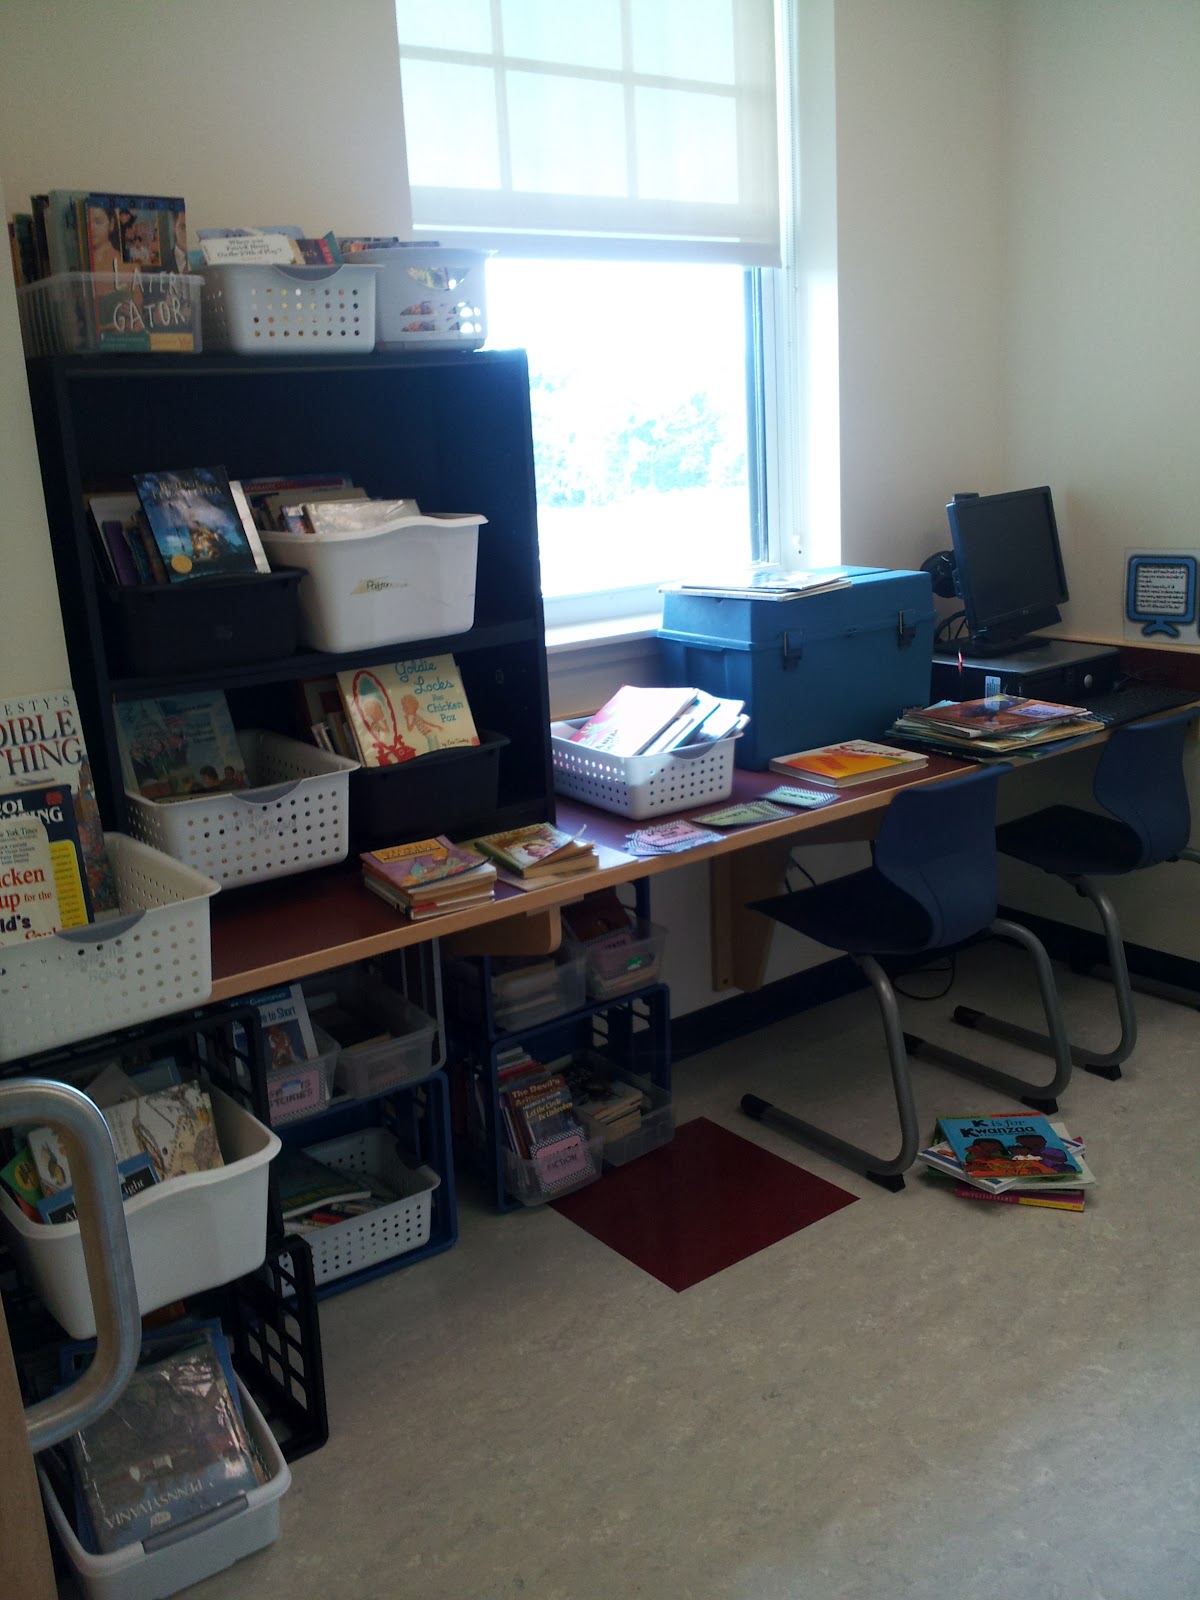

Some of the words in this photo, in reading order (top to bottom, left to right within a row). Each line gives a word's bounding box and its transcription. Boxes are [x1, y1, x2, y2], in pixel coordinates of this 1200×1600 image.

[113, 299, 186, 334] GATOR
[395, 659, 437, 682] Goldie
[414, 675, 454, 695] Locks
[4, 694, 70, 716] ESTY'S
[427, 702, 464, 714] Chicken
[0, 736, 82, 776] HING
[0, 867, 46, 889] cken
[38, 891, 52, 901] the
[511, 1088, 529, 1099] The
[529, 1078, 561, 1093] Devil's
[960, 1126, 1036, 1138] Kwanzaa
[972, 1119, 988, 1128] K
[1003, 1119, 1025, 1128] for
